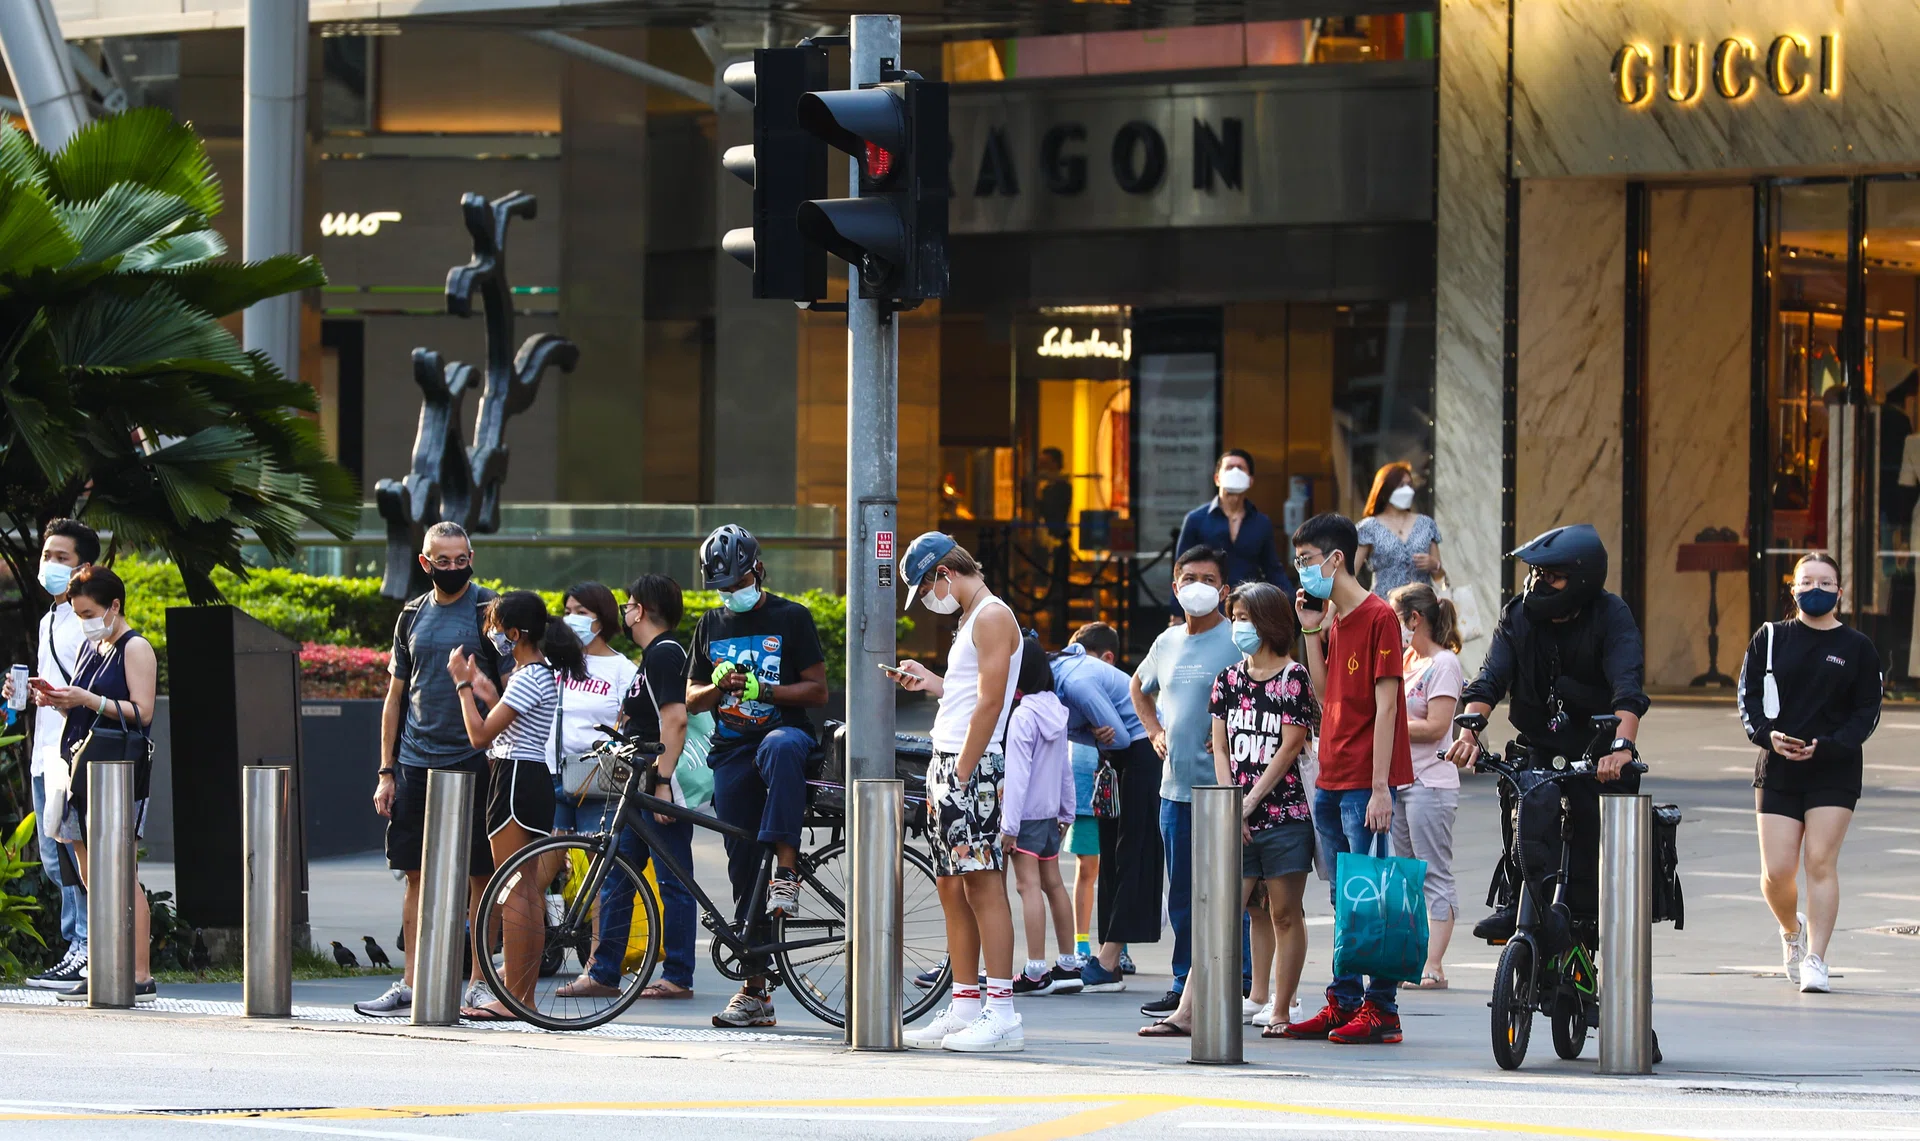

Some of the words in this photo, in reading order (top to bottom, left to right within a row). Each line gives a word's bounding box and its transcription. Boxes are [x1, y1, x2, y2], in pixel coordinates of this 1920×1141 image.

[1611, 34, 1842, 106] GUCCI
[949, 116, 1244, 197] AGON
[763, 640, 780, 651] Gulf
[1227, 708, 1257, 731] FALL
[1261, 711, 1281, 734] IN
[1229, 733, 1278, 765] LOVE
